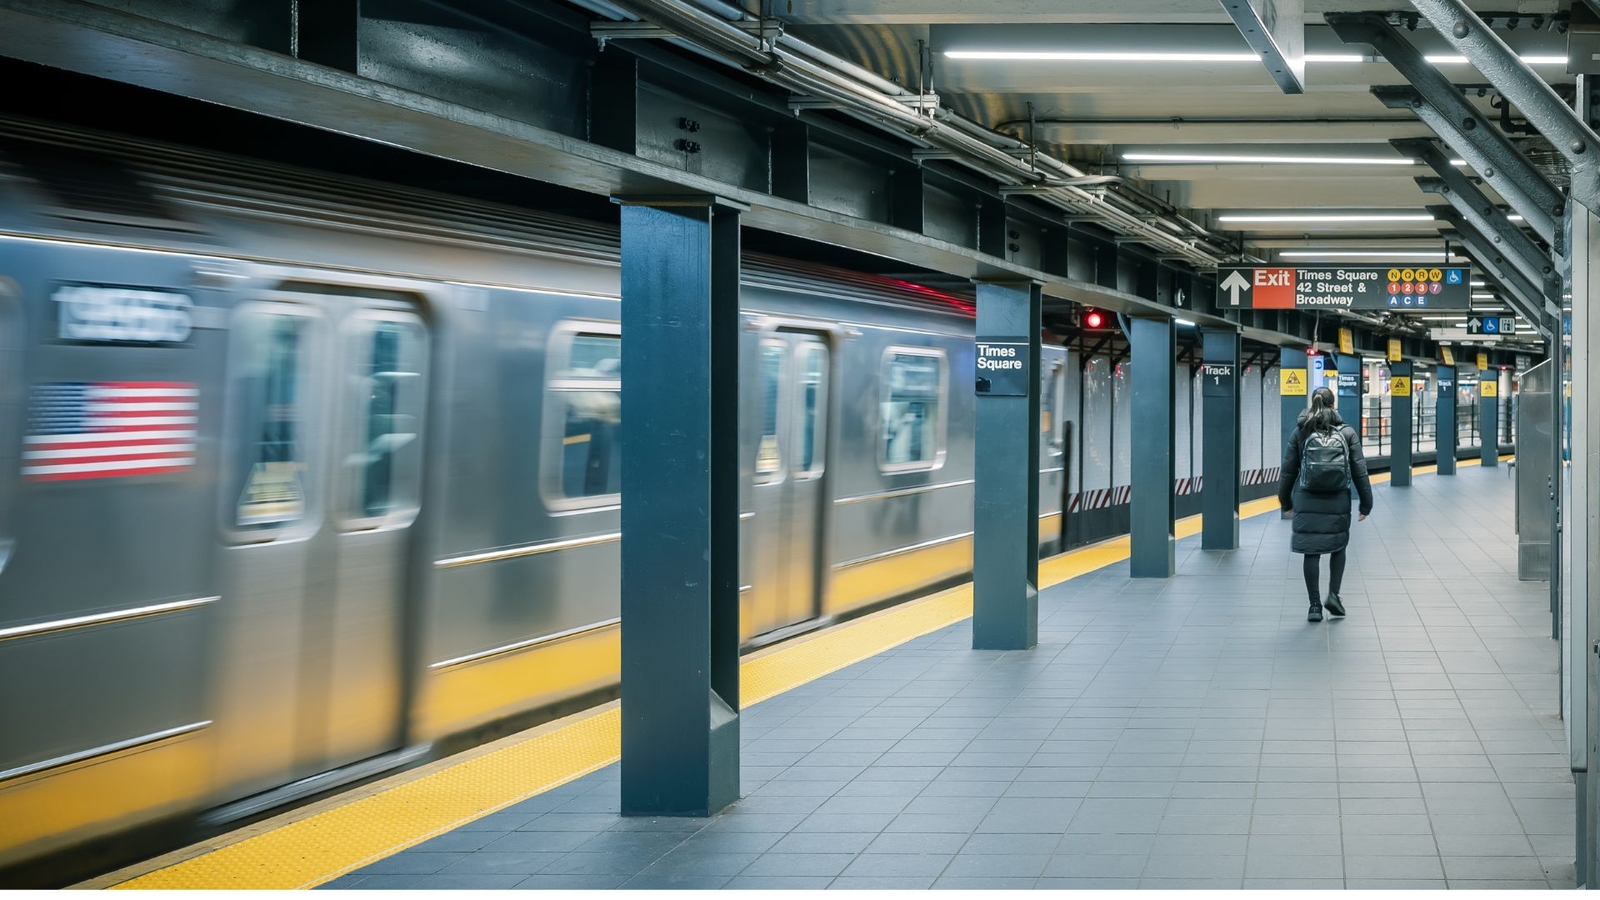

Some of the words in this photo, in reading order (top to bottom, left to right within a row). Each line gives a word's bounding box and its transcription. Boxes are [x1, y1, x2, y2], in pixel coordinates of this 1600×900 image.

[1254, 270, 1290, 286] Exit
[1297, 270, 1332, 280] Times
[1336, 270, 1378, 282] Square
[1296, 282, 1312, 292] 42
[1316, 282, 1353, 293] Street
[1357, 282, 1366, 292] &
[1296, 294, 1353, 306] Broadway
[977, 345, 1016, 357] Times
[977, 357, 1022, 371] Square
[1204, 365, 1231, 375] Track
[1214, 376, 1219, 385] 1
